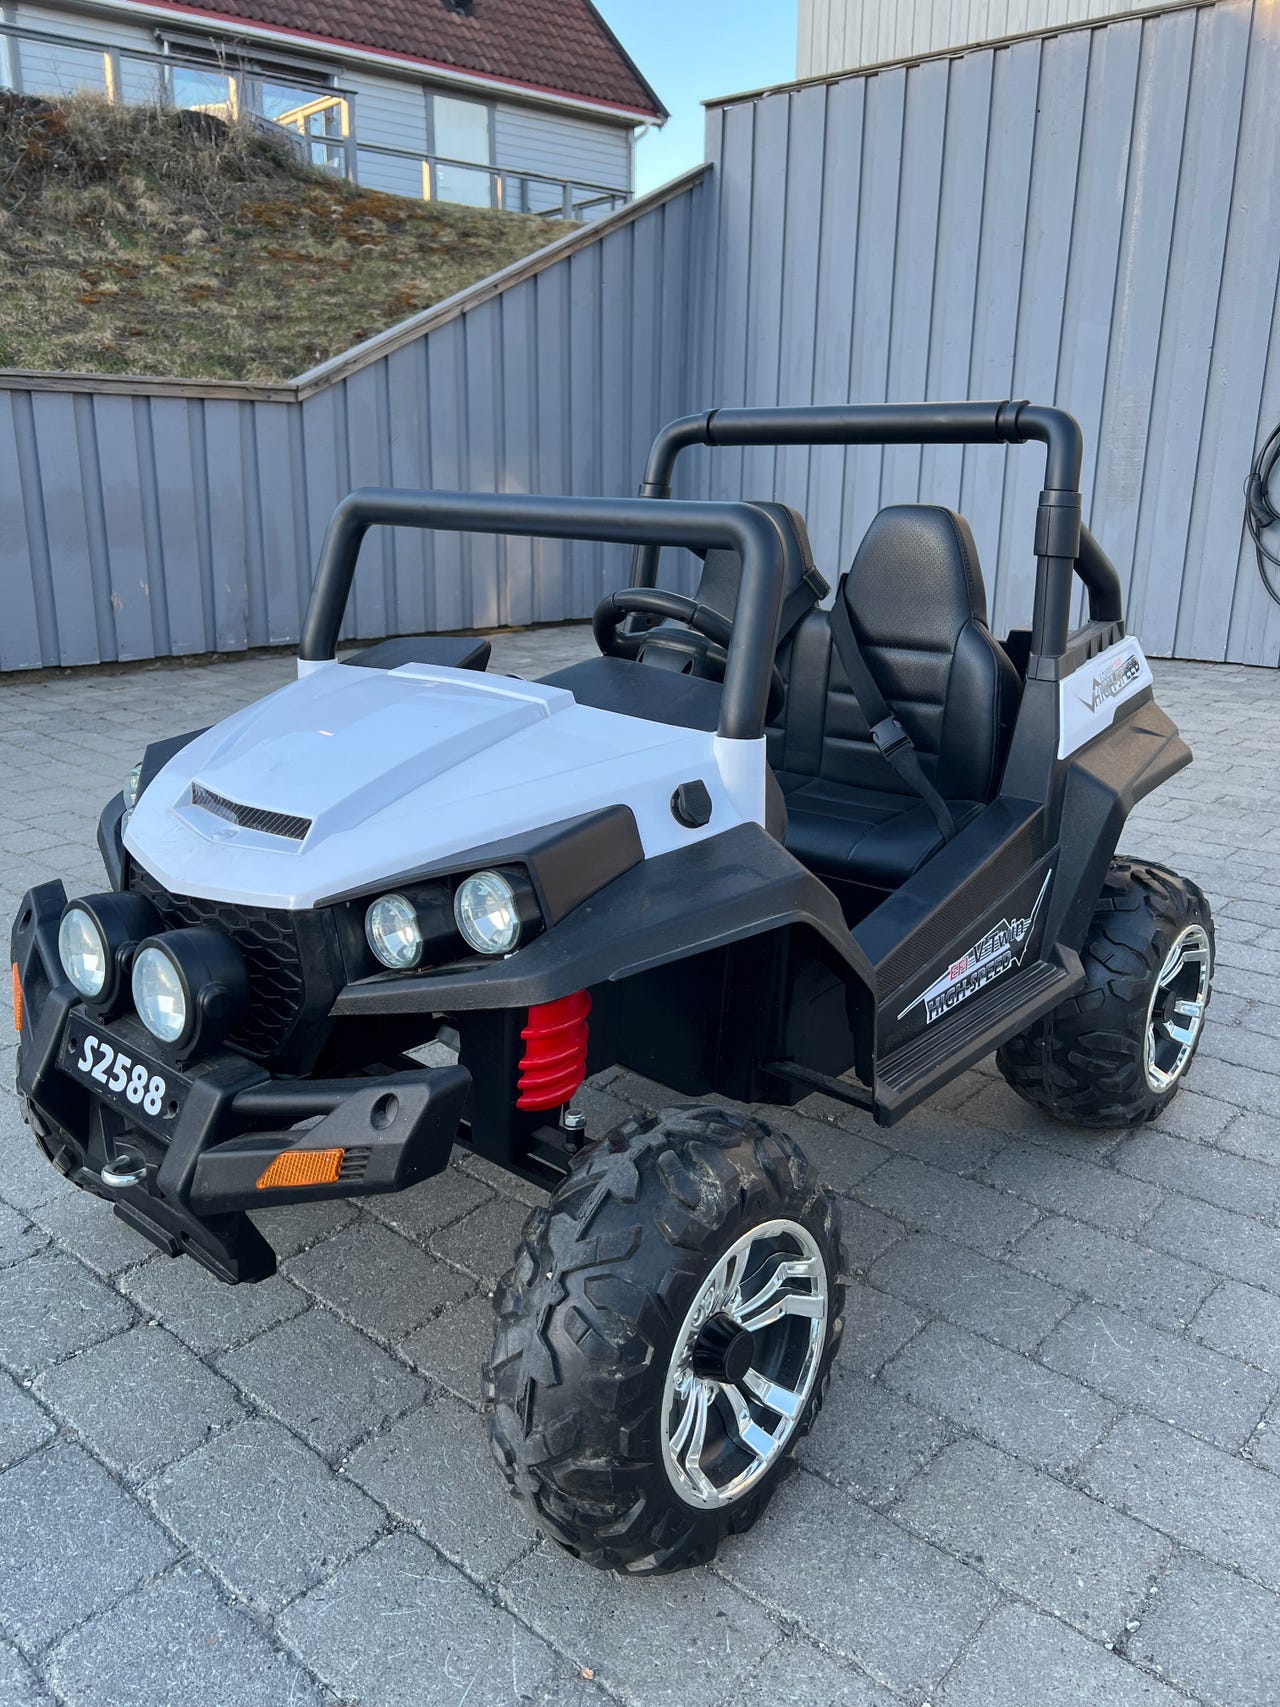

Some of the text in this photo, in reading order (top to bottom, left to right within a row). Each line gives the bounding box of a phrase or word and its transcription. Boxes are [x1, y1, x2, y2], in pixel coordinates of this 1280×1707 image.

[926, 951, 1012, 1021] HIGH-SPEED
[950, 956, 969, 982] EFI
[78, 1035, 166, 1116] S2588
